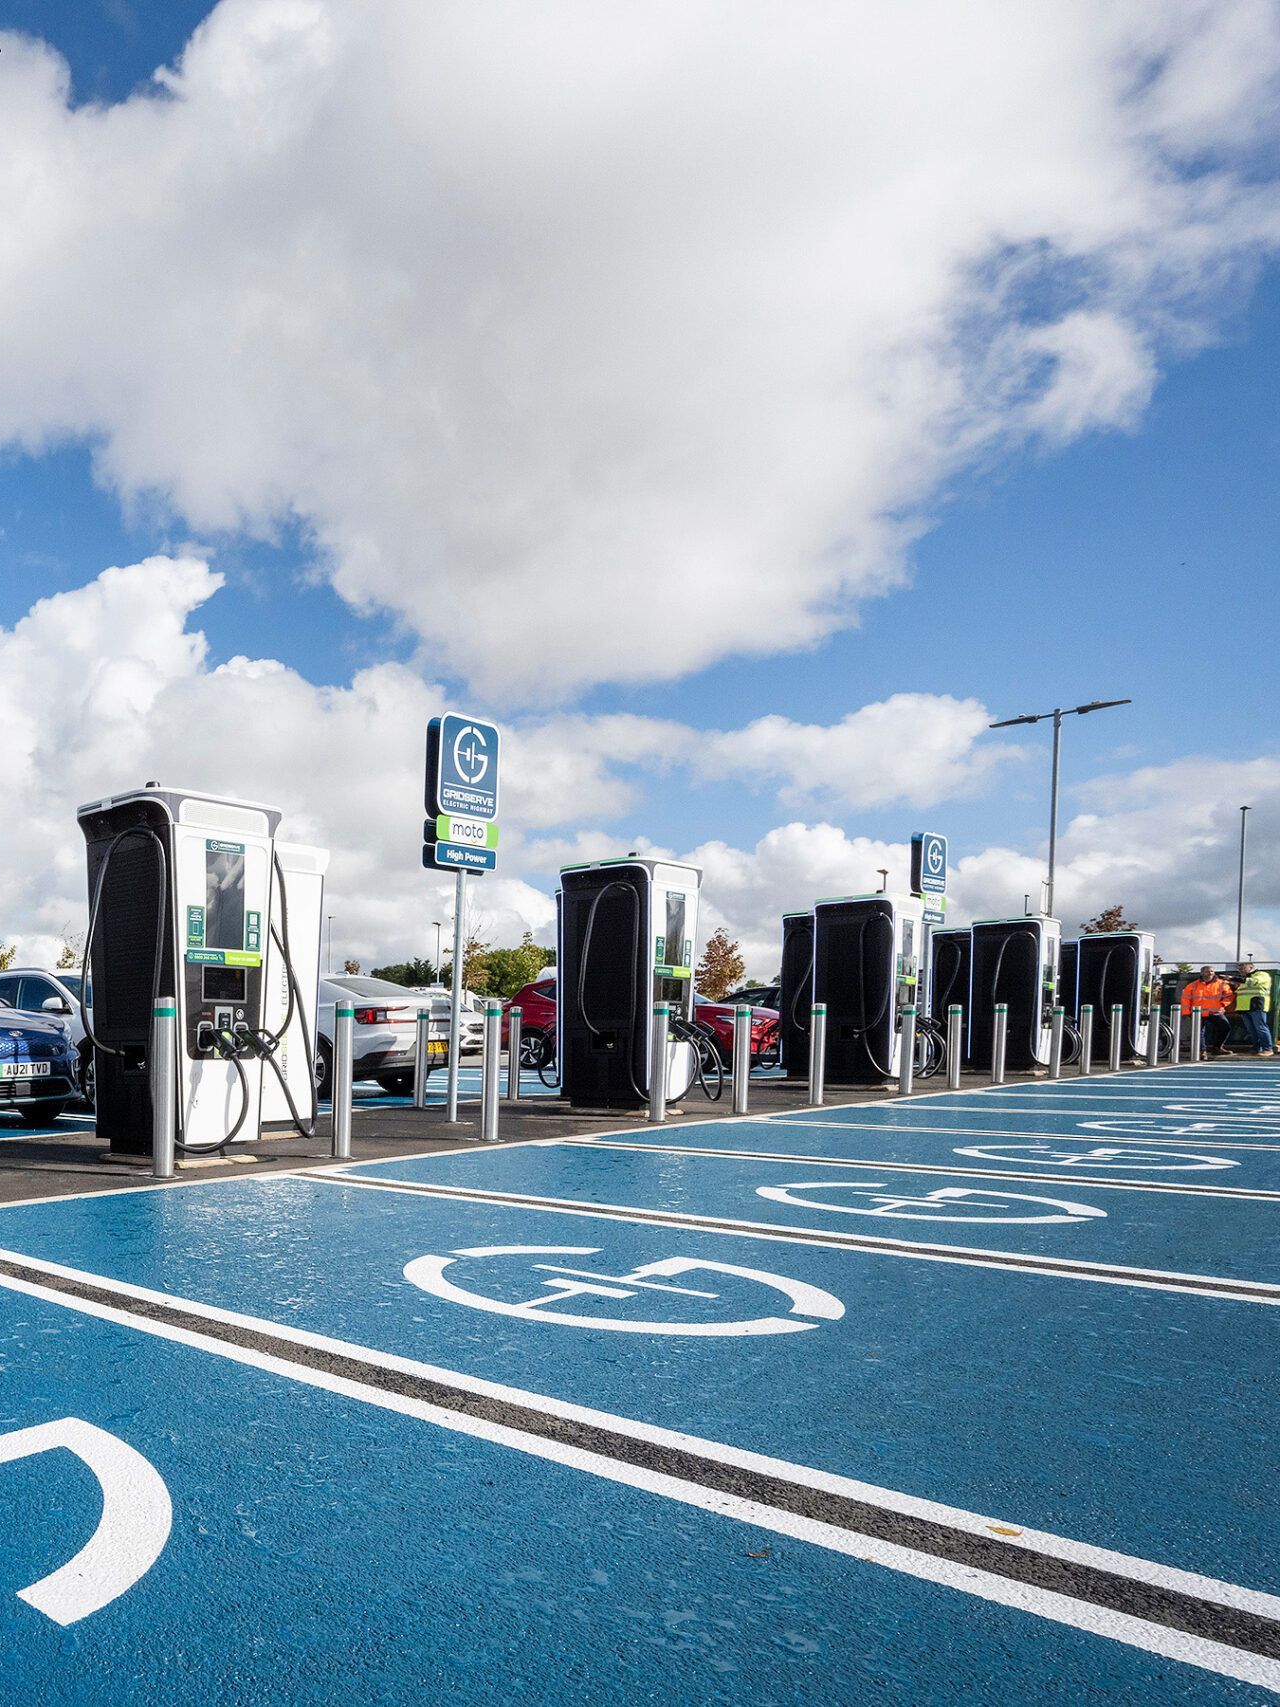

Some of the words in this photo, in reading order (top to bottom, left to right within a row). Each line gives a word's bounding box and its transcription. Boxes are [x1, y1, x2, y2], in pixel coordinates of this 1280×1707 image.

[443, 788, 494, 806] GRIDSERVE
[443, 800, 469, 810] ELECTRIC
[470, 805, 493, 814] HIGHWAY
[452, 823, 484, 839] moto
[446, 849, 464, 862] High
[465, 852, 487, 864] Power
[7, 1064, 28, 1075] AU21
[30, 1063, 47, 1074] TVD
